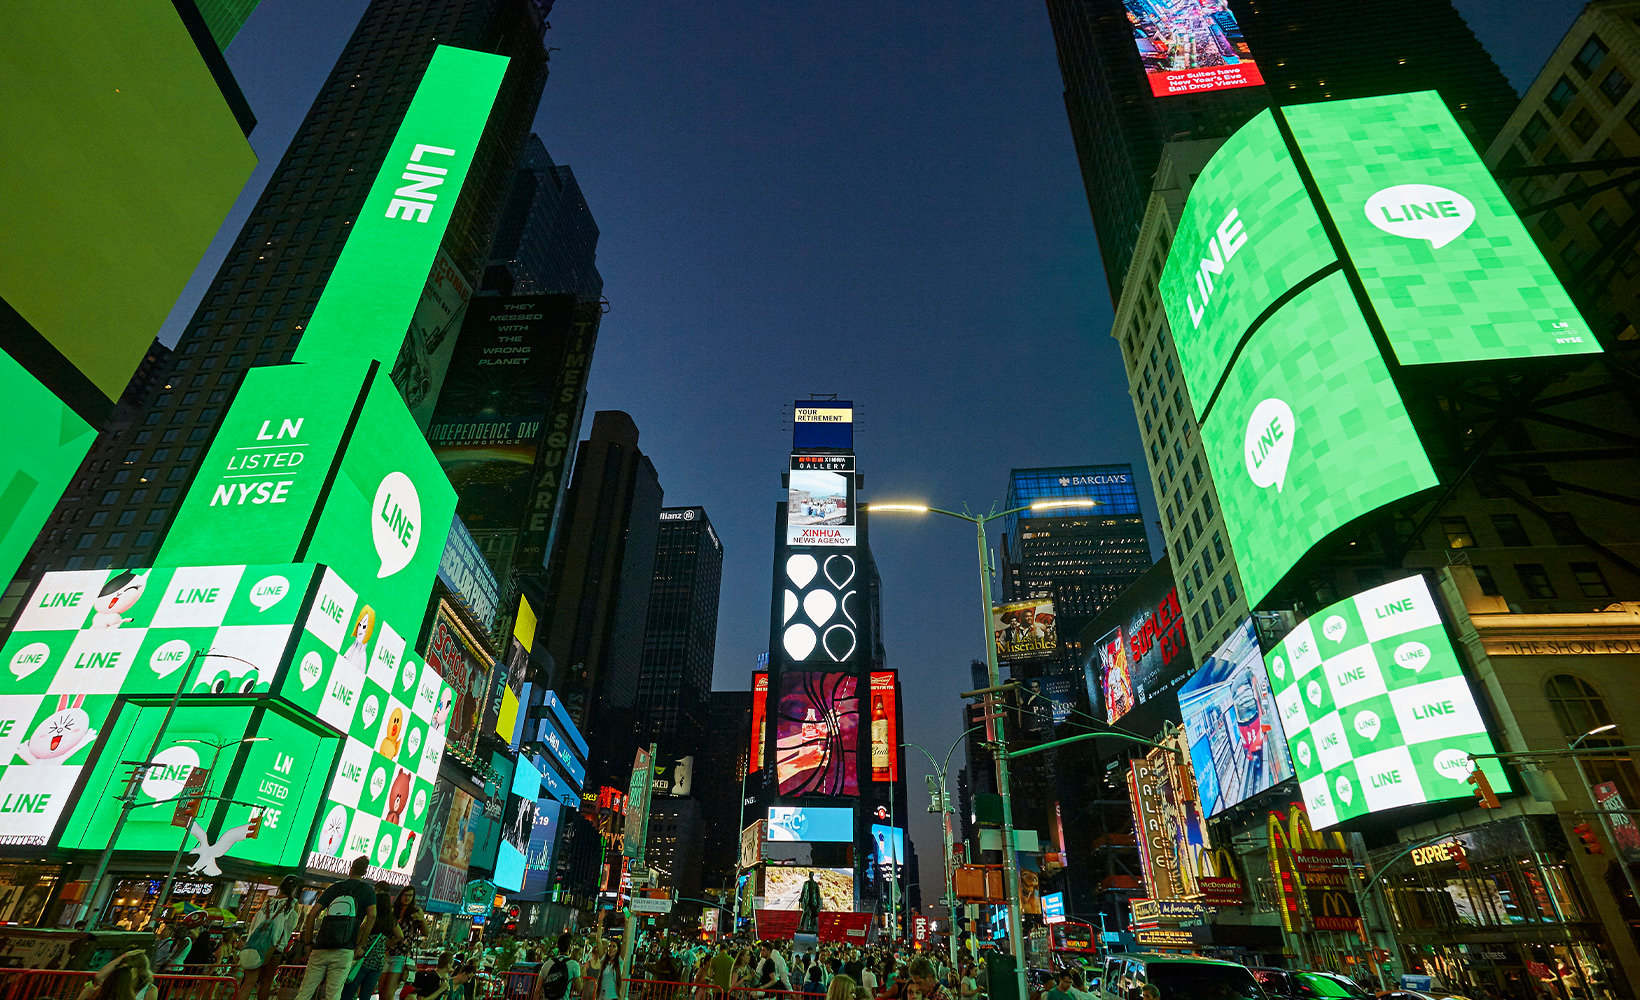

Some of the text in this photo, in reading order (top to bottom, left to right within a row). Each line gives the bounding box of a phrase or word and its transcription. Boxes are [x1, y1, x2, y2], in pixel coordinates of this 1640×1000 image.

[385, 143, 456, 224] LINE
[1380, 200, 1461, 224] LINE
[1186, 207, 1248, 330] LINE
[489, 313, 544, 321] MESSED
[503, 303, 536, 312] THEY
[497, 335, 523, 343] THE
[482, 346, 532, 354] WRONG
[478, 357, 530, 366] PLANET
[256, 417, 305, 440] LN
[428, 421, 540, 441] INDEPENDENCE DAY
[1251, 416, 1284, 469] LINE
[226, 452, 304, 471] LISTED
[530, 414, 571, 532] SQUARE
[1072, 475, 1127, 485] BARCLAYS
[210, 481, 293, 507] NYSE
[381, 492, 414, 550] LINE
[802, 529, 841, 537] XINHUA
[817, 537, 851, 545] AGENCY
[40, 592, 84, 608] LINE
[175, 588, 220, 604] LINE
[255, 584, 283, 598] LINE
[320, 594, 344, 624] LINE
[1375, 598, 1414, 619] LINE
[1130, 586, 1181, 663] SUPLEX
[1160, 616, 1186, 665] CIT
[1294, 641, 1309, 659] LINE
[1508, 641, 1546, 654] THE
[1547, 641, 1597, 654] SHOW
[17, 653, 43, 664] LINE
[74, 652, 122, 669] LINE
[157, 651, 184, 662] LINE
[378, 645, 396, 670] LINE
[1400, 649, 1425, 662] LINE
[303, 660, 319, 677] LINE
[1338, 666, 1367, 686] LINE
[331, 681, 354, 706] LINE
[1285, 701, 1299, 719] LINE
[1412, 700, 1456, 720] LINE
[1358, 718, 1376, 729] LINE
[1321, 732, 1339, 750] LINE
[148, 764, 192, 781] LINE
[273, 752, 294, 775] LN
[341, 760, 362, 783] LINE
[1440, 758, 1468, 770] LINE
[1371, 769, 1402, 788] LINE
[259, 779, 289, 799] LISTED
[1, 793, 52, 813] LINE
[1140, 767, 1168, 868] PALACE
[349, 835, 370, 854] LINE
[1411, 840, 1466, 866] EXPRE
